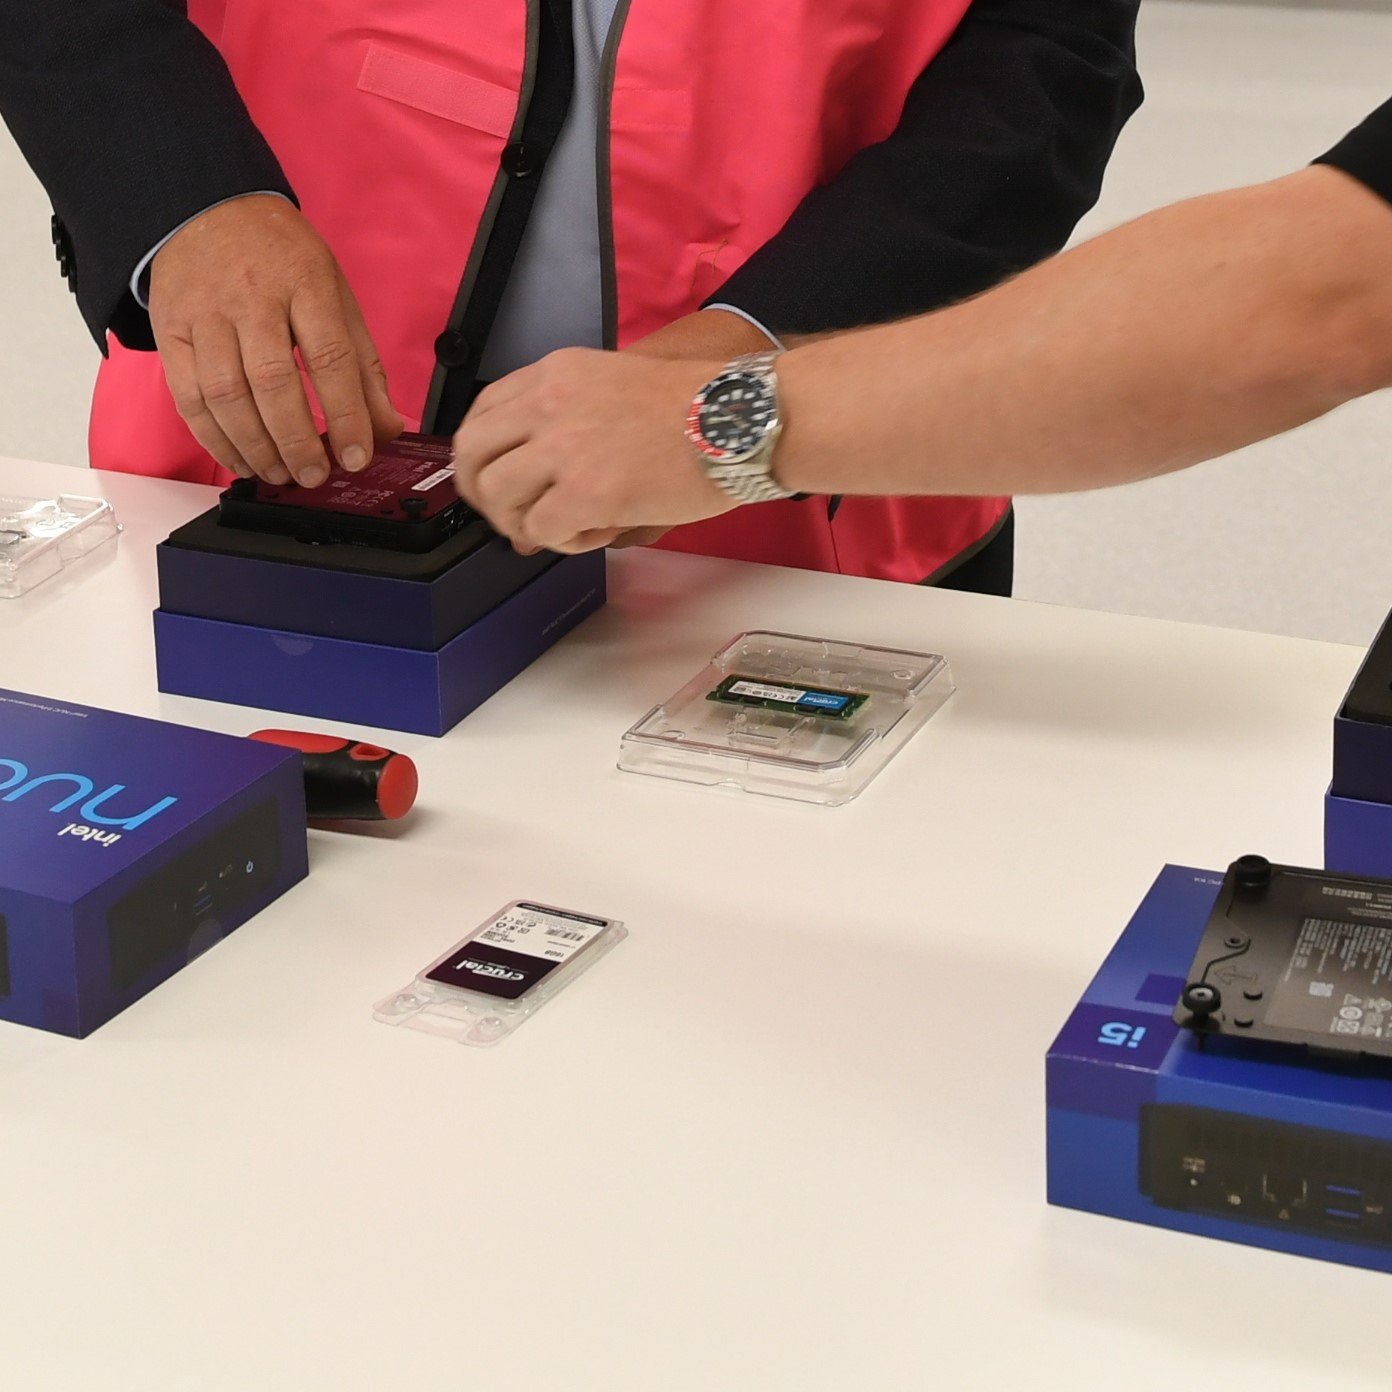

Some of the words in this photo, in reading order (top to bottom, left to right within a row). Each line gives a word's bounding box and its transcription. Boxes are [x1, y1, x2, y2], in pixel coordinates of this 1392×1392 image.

[57, 822, 122, 848] intel
[455, 959, 525, 981] crucial
[1097, 1021, 1148, 1049] i5
